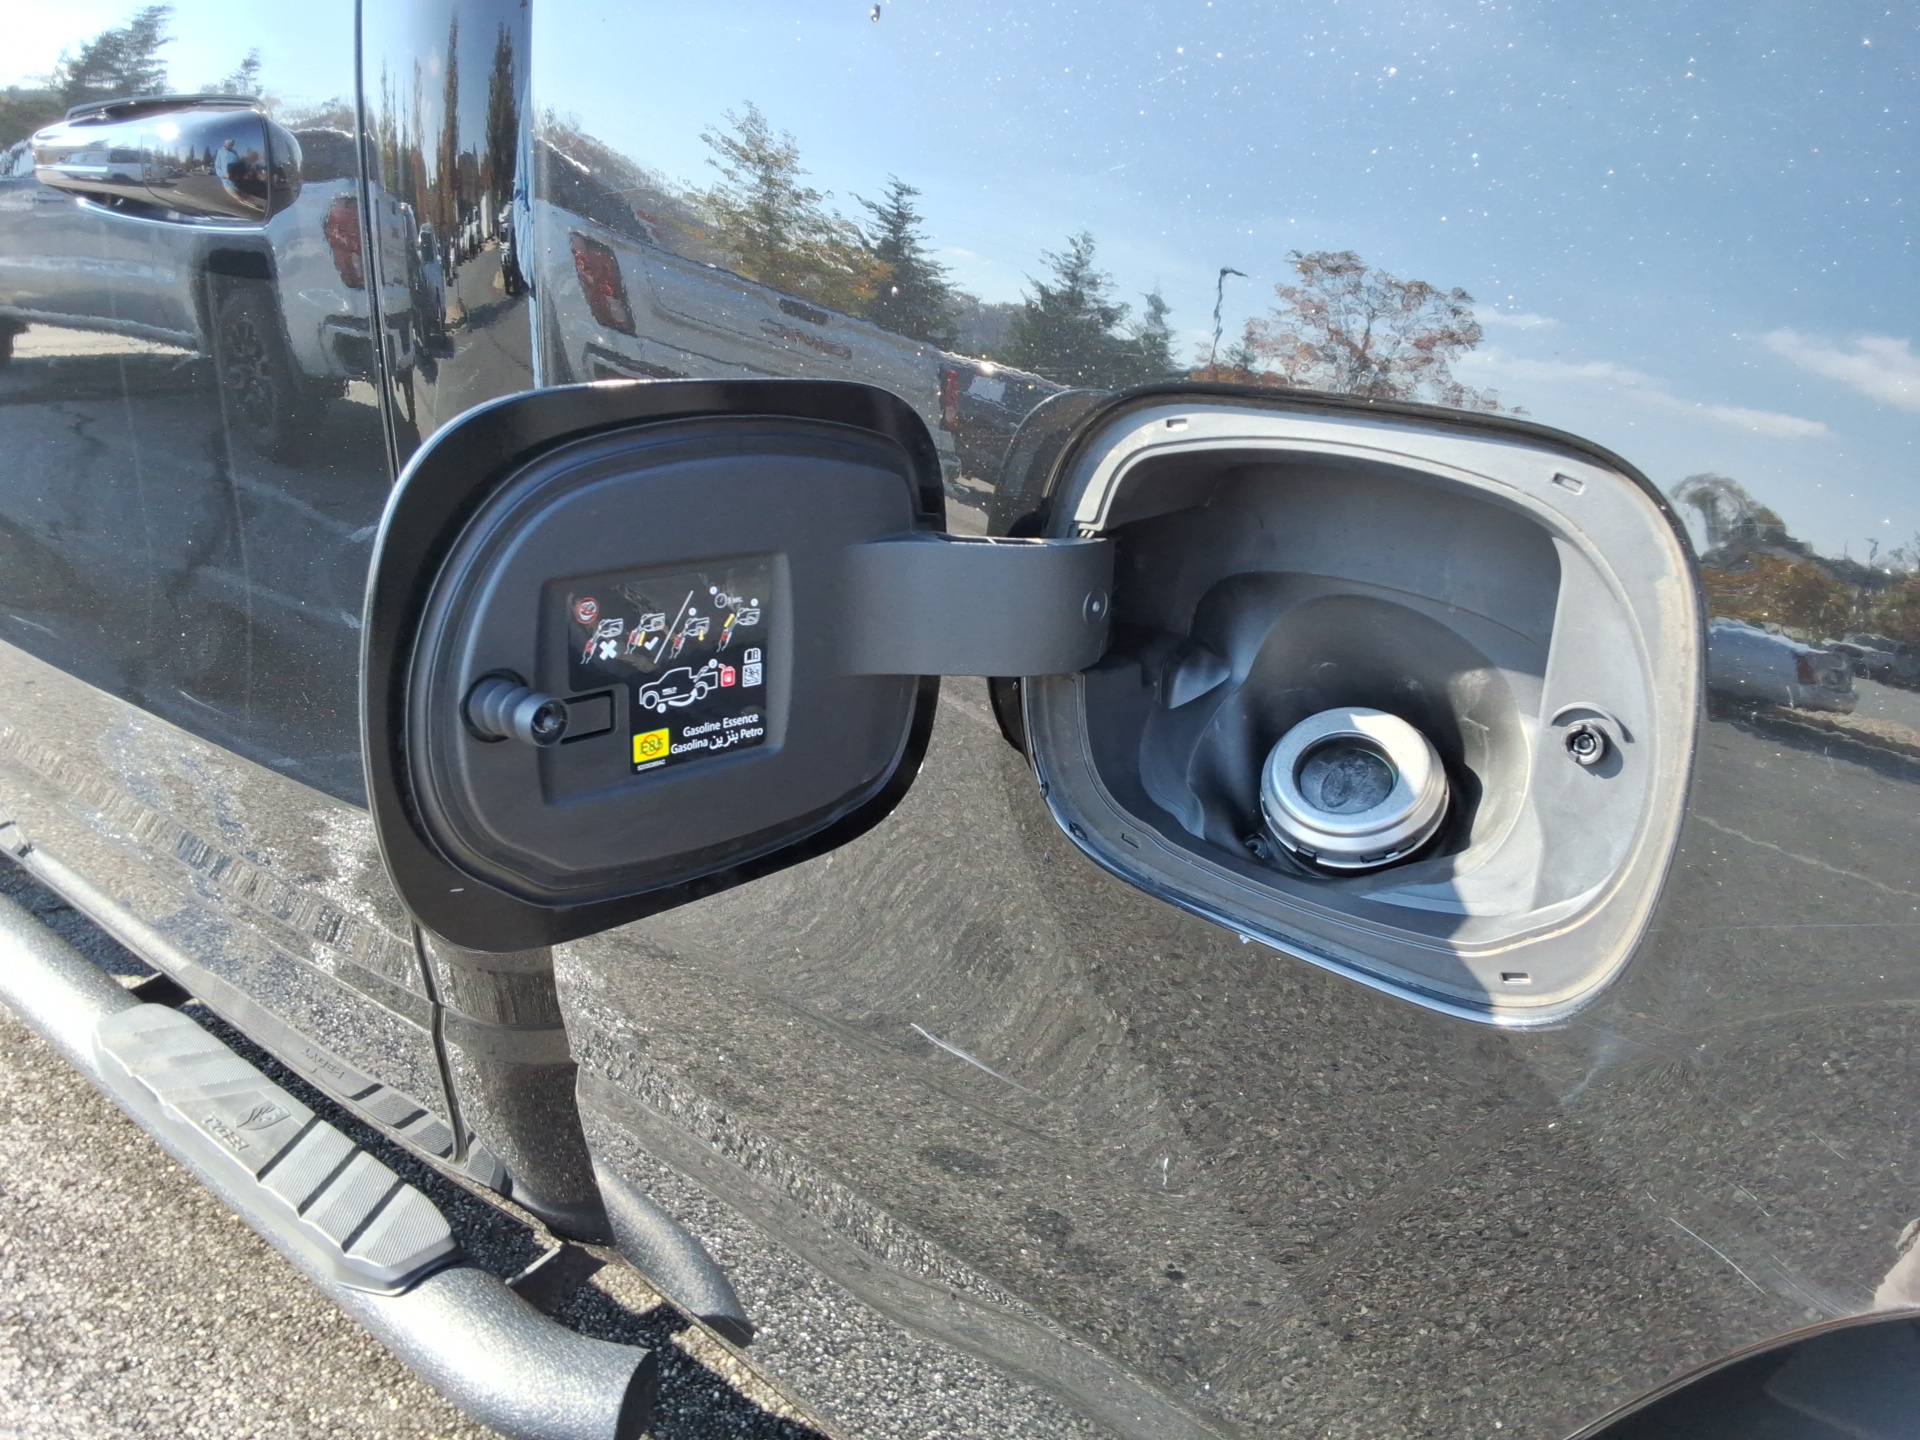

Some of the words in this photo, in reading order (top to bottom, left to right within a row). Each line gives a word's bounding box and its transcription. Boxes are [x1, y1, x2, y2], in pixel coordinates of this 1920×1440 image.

[682, 722, 721, 737] Gasoline
[722, 713, 759, 729] Essence
[670, 737, 709, 754] Gasolina
[709, 730, 739, 750] بنزين
[740, 727, 763, 739] Petro
